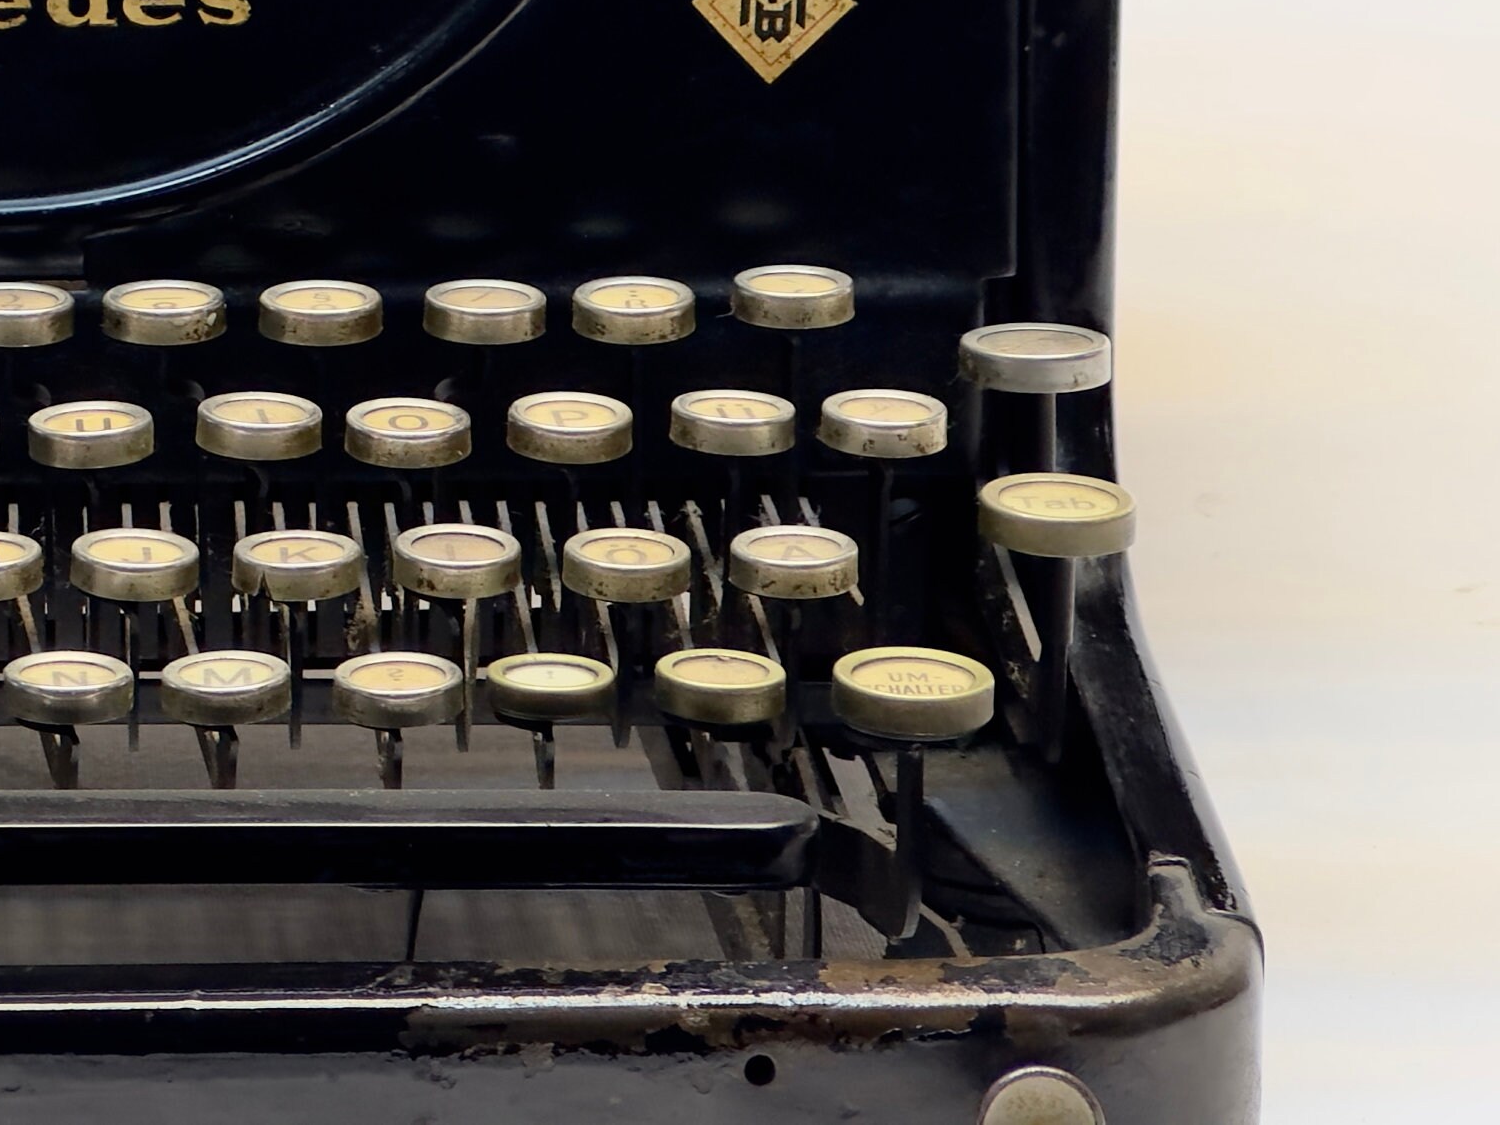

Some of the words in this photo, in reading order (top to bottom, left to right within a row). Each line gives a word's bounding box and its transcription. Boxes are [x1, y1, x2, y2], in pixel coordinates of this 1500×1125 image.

[388, 413, 429, 431] O
[550, 408, 590, 424] P
[75, 417, 112, 433] U
[1012, 496, 1097, 510] Tab
[278, 546, 319, 564] K
[604, 543, 648, 564] Ö
[50, 669, 90, 686] N
[201, 667, 254, 686] M
[886, 672, 943, 683] UM-
